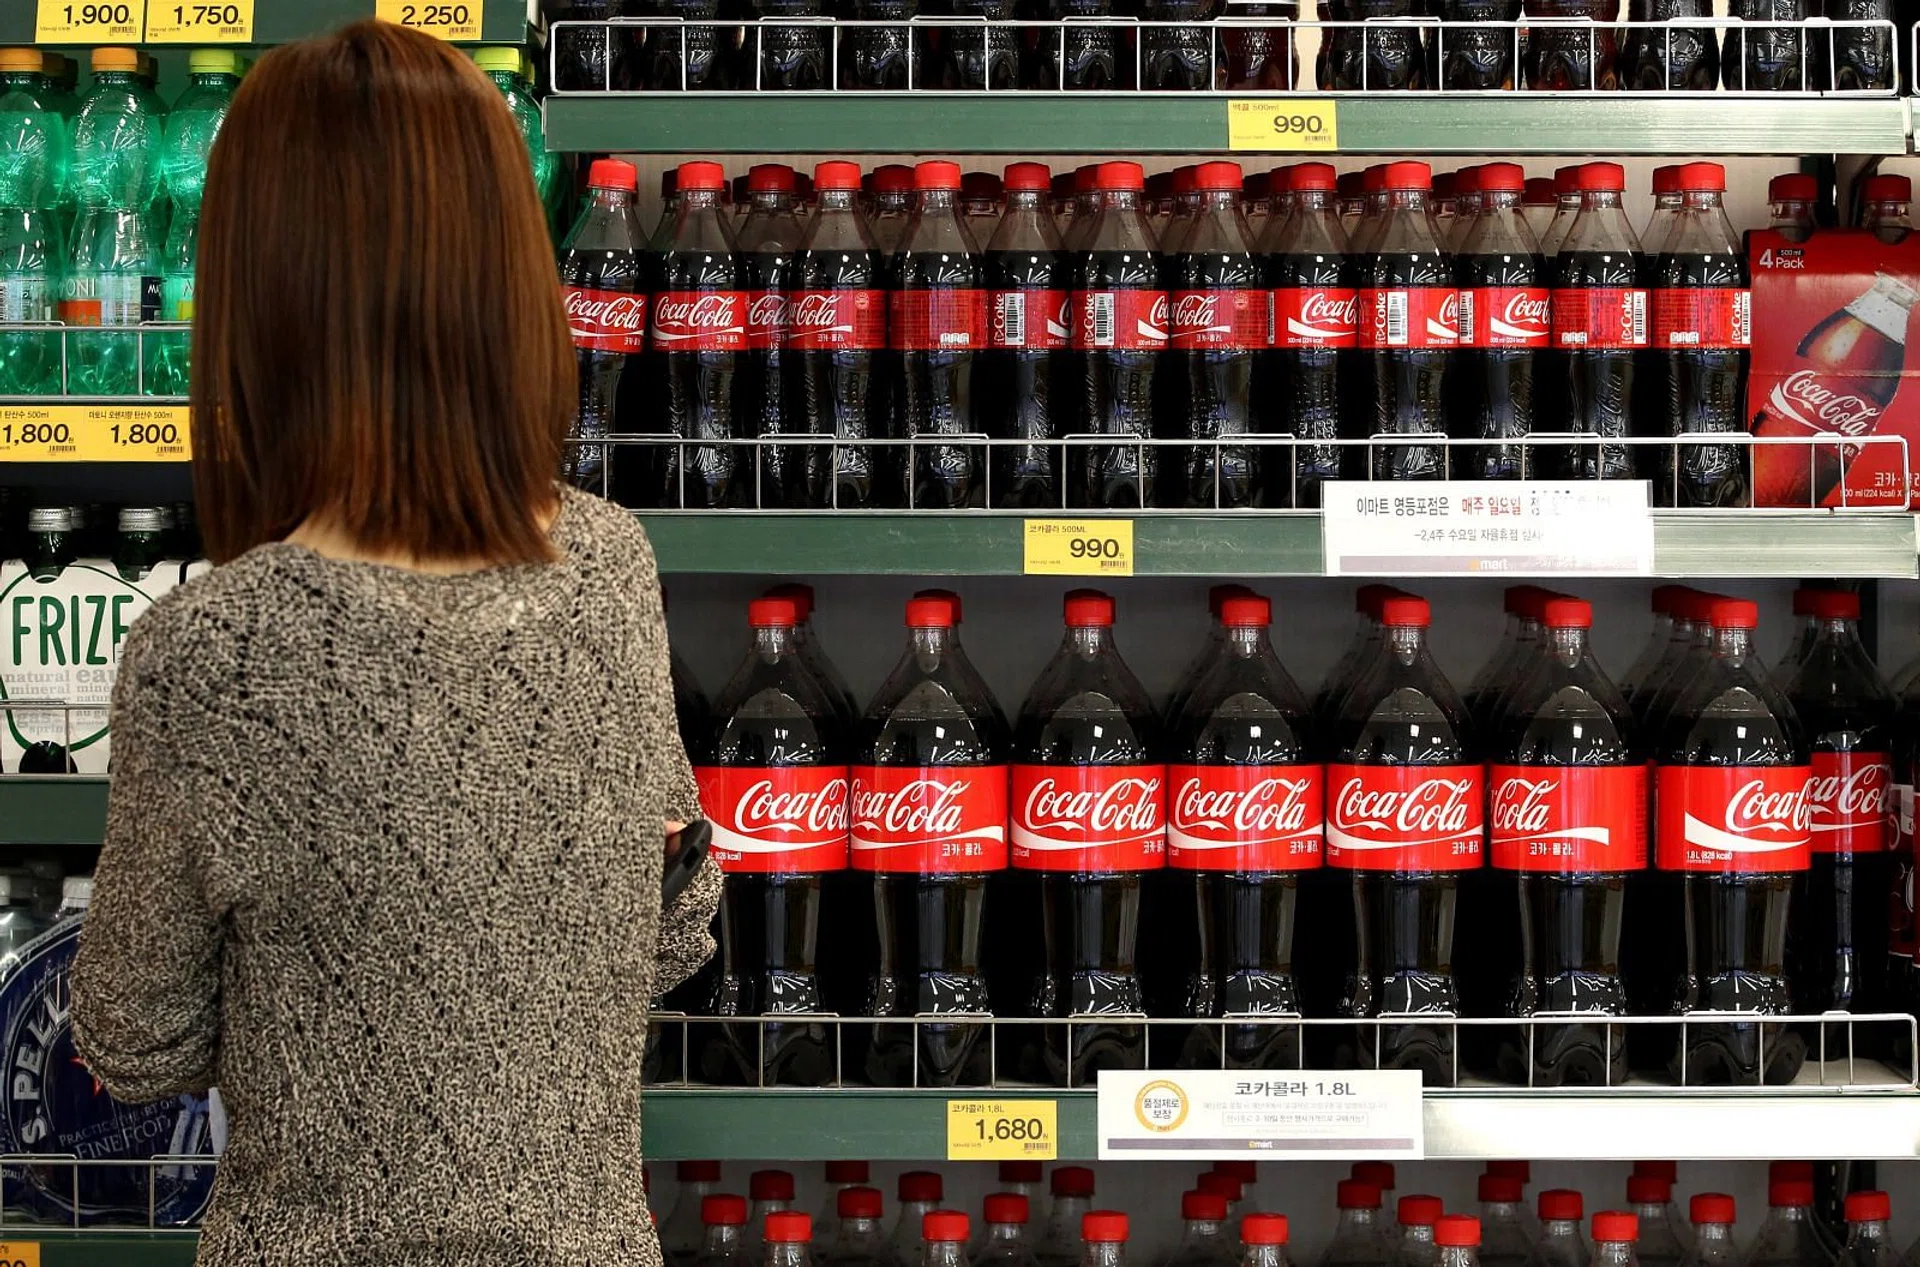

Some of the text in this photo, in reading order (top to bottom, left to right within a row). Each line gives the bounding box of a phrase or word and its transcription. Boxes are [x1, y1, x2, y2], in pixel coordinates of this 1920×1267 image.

[1760, 248, 1804, 268] 4 Pack
[656, 295, 737, 327] Coca-Cola
[993, 293, 1005, 329] Coke
[1084, 293, 1095, 329] Coke
[1375, 292, 1386, 329] Coke
[1620, 292, 1632, 328] Coke
[1731, 292, 1742, 328] Coke
[1783, 369, 1880, 438] Coca-Cola
[1357, 496, 1390, 516] 이마트
[1394, 496, 1449, 516] 영등포점은
[1462, 496, 1484, 515] 매주
[1488, 496, 1521, 515] 일요일
[1448, 529, 1477, 541] 수요일
[5, 670, 70, 683] natural
[11, 684, 70, 695] mineral
[734, 780, 849, 833] Coca-Col
[1025, 778, 1161, 832] Coca-Cola
[1177, 778, 1311, 832] Coca-Cola
[1336, 778, 1473, 832] Coca-Cola
[1235, 1082, 1356, 1097] 코카콜라 1.8L
